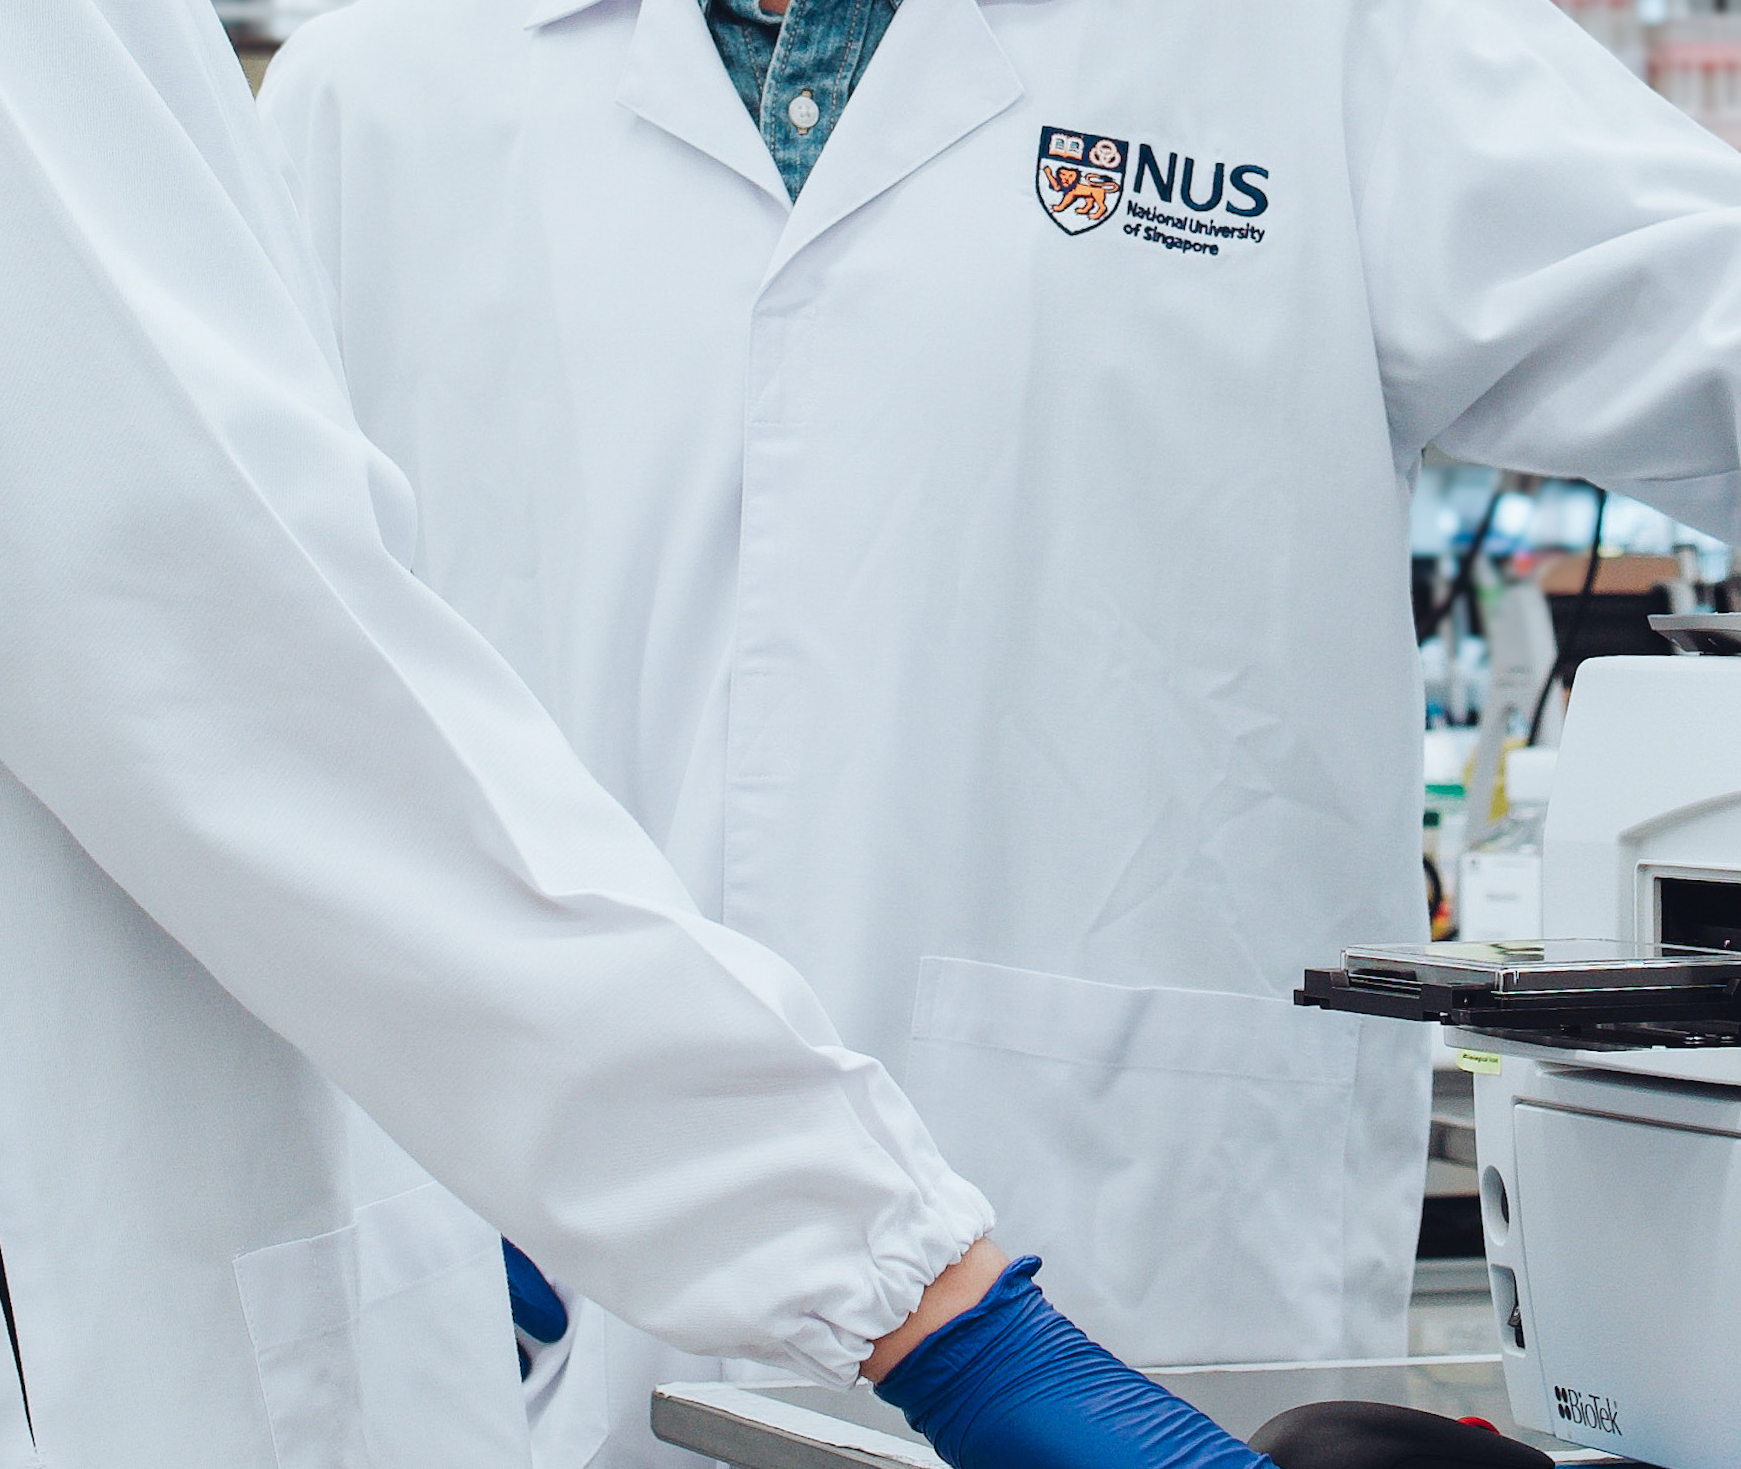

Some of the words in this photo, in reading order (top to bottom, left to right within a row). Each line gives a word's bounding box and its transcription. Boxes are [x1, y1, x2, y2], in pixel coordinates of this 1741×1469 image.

[1133, 143, 1269, 217] NUS
[1123, 223, 1142, 237] of
[1143, 225, 1219, 256] Singapore
[1127, 199, 1188, 231] National
[1188, 218, 1266, 243] University
[1567, 1388, 1623, 1436] BioTek
